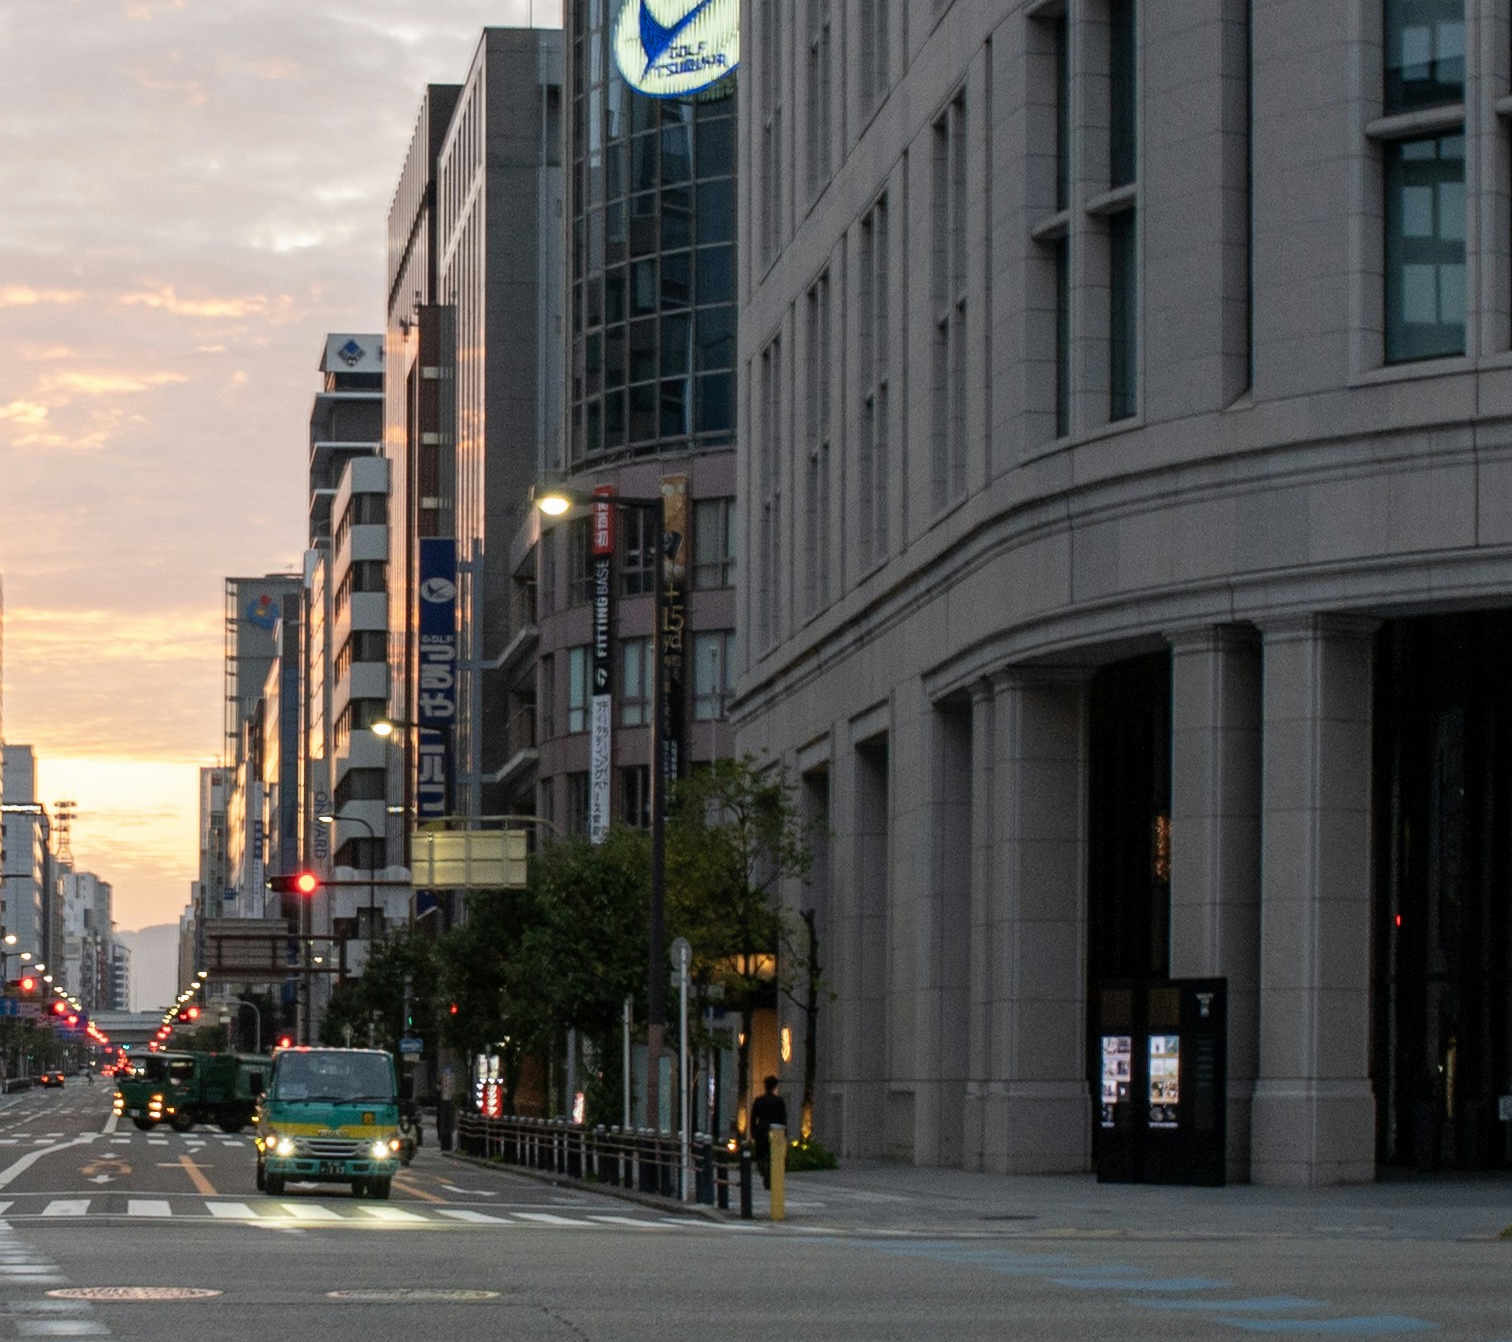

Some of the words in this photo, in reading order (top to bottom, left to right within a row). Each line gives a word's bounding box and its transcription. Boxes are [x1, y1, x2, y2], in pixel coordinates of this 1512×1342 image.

[669, 41, 708, 60] GOLF
[596, 559, 609, 595] BASE
[595, 597, 609, 658] FITTING
[314, 791, 329, 859] ONWARD
